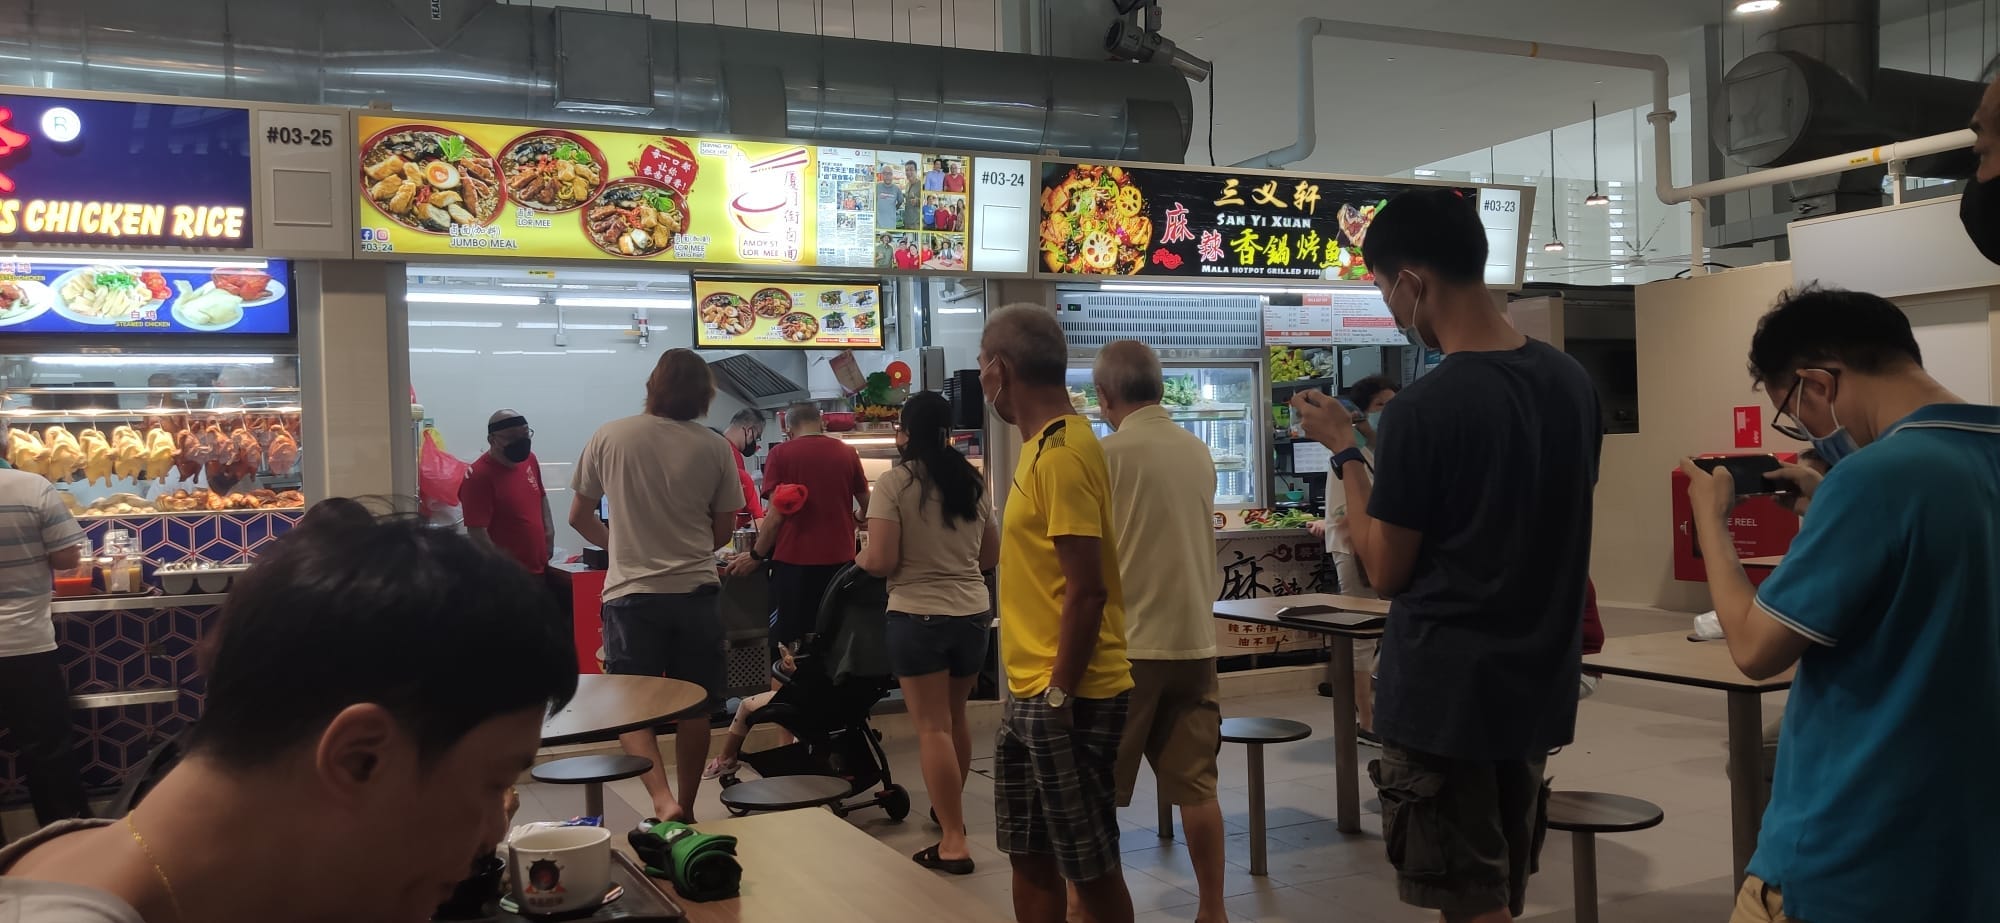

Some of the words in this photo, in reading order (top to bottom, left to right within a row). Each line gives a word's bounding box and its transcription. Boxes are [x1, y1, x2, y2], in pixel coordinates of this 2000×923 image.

[266, 126, 333, 146] #03-25
[982, 171, 1024, 187] #03-24
[1213, 178, 1322, 215] 三义轩
[1484, 199, 1516, 213] #03-23
[24, 200, 165, 236] CHICKEN
[172, 205, 245, 239] RICE
[361, 243, 393, 252] #03-24
[451, 238, 487, 247] JUMBO
[490, 239, 517, 248] MEAL
[690, 244, 705, 252] MEE
[743, 248, 760, 256] LOR
[763, 249, 779, 257] MEE
[1735, 517, 1758, 527] REEL
